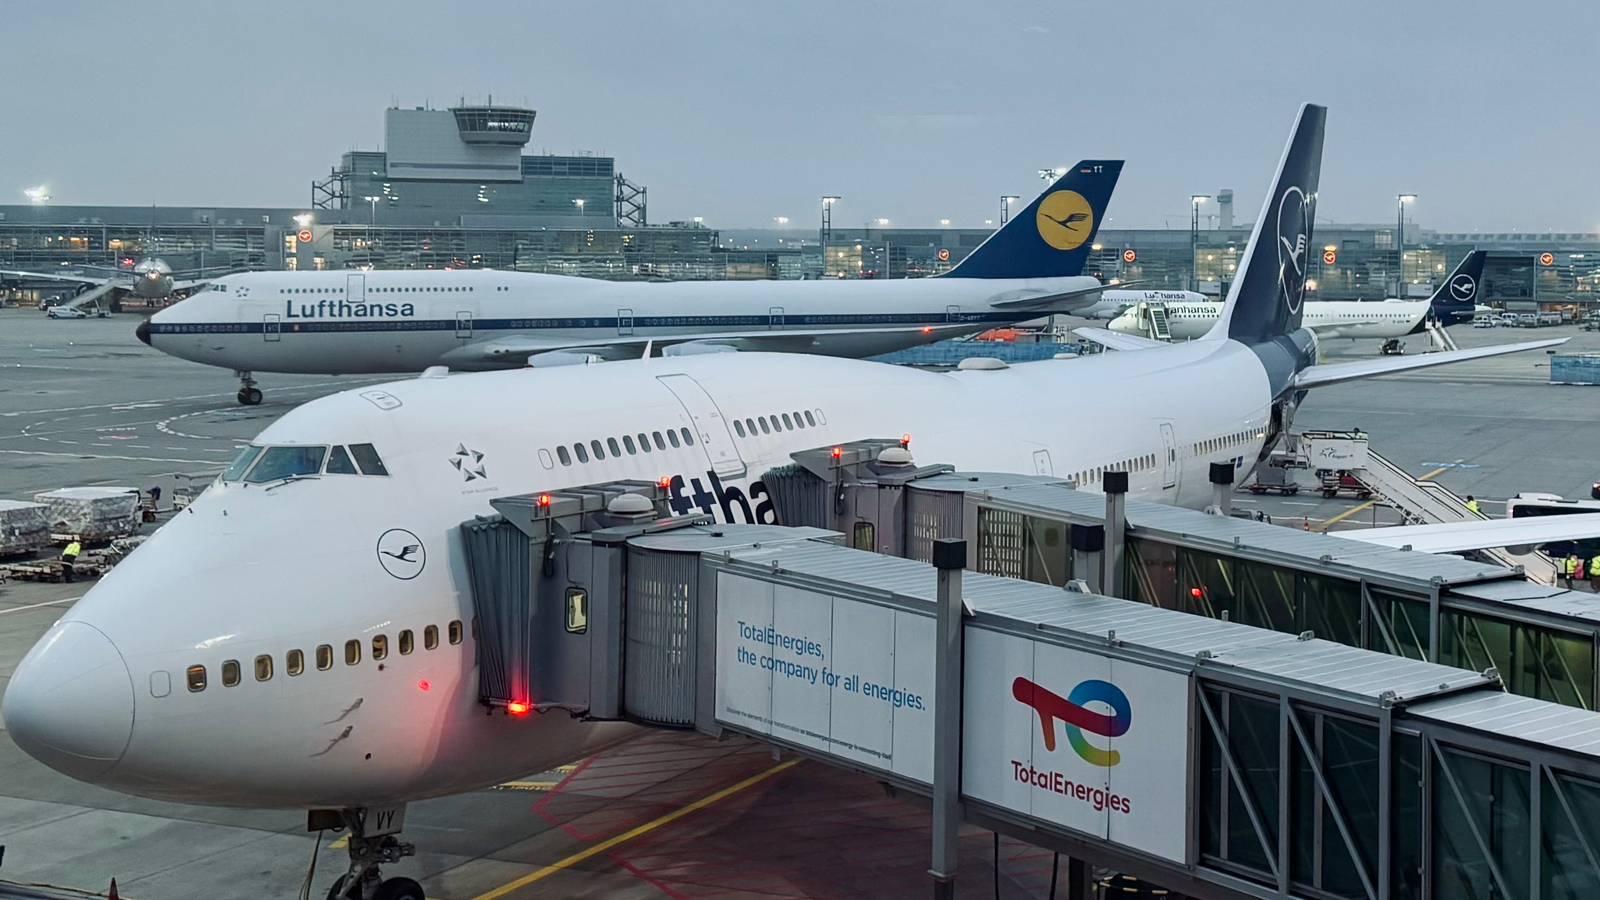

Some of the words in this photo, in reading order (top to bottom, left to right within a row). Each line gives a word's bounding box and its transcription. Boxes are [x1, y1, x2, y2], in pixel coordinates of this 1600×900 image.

[286, 299, 415, 318] Lufthansa
[1144, 291, 1186, 299] Luhansa
[1169, 305, 1217, 314] anhansa
[669, 470, 779, 525] ftha
[738, 620, 825, 661] TotalEnergies,
[738, 646, 757, 666] the
[760, 655, 818, 685] company
[822, 667, 840, 688] for
[844, 674, 859, 693] all
[863, 681, 926, 711] energies.
[1011, 760, 1131, 814] TotalEnergies
[377, 810, 396, 831] VY
